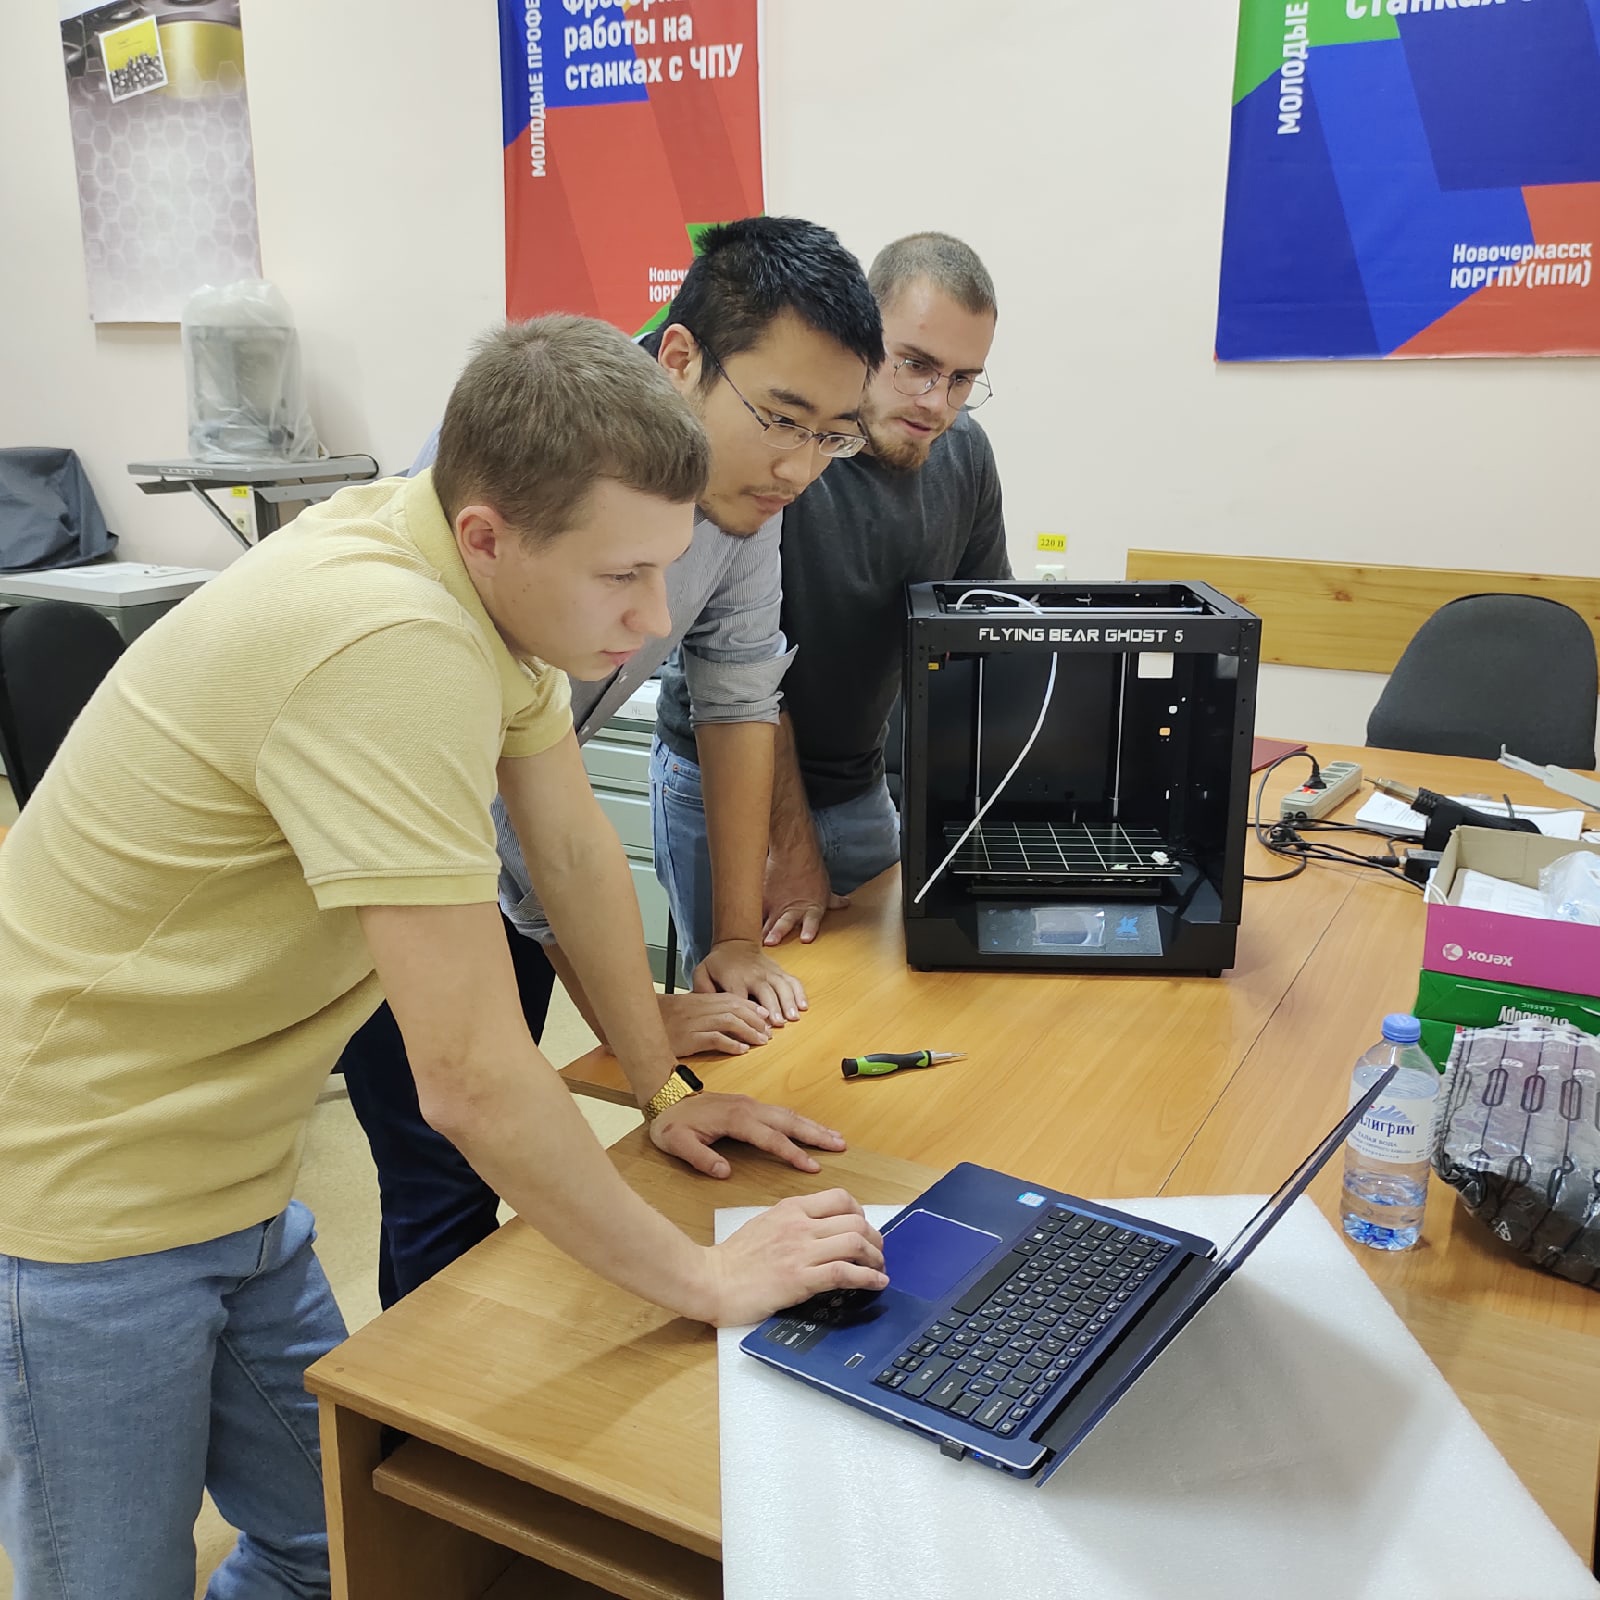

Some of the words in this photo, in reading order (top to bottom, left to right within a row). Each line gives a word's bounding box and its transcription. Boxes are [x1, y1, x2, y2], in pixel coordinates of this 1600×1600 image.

[564, 16, 656, 59] работы
[663, 14, 693, 43] на
[565, 57, 663, 90] станках
[668, 53, 683, 82] с
[690, 43, 743, 80] ЧПУ
[1277, 1, 1310, 135] МОЛОДЫЕ
[528, 72, 546, 177] МОЛОДЫЕ
[1452, 243, 1593, 264] Новочеркасск
[1449, 260, 1592, 289] ЮРГПУ(НПИ)
[648, 284, 682, 303] ЮРГ
[978, 627, 1045, 642] FLYING
[1048, 628, 1100, 643] BEAR
[1104, 629, 1168, 643] GHOST
[1174, 629, 1184, 643] 5
[1467, 950, 1513, 967] xerox
[1359, 1117, 1416, 1138] лигрим
